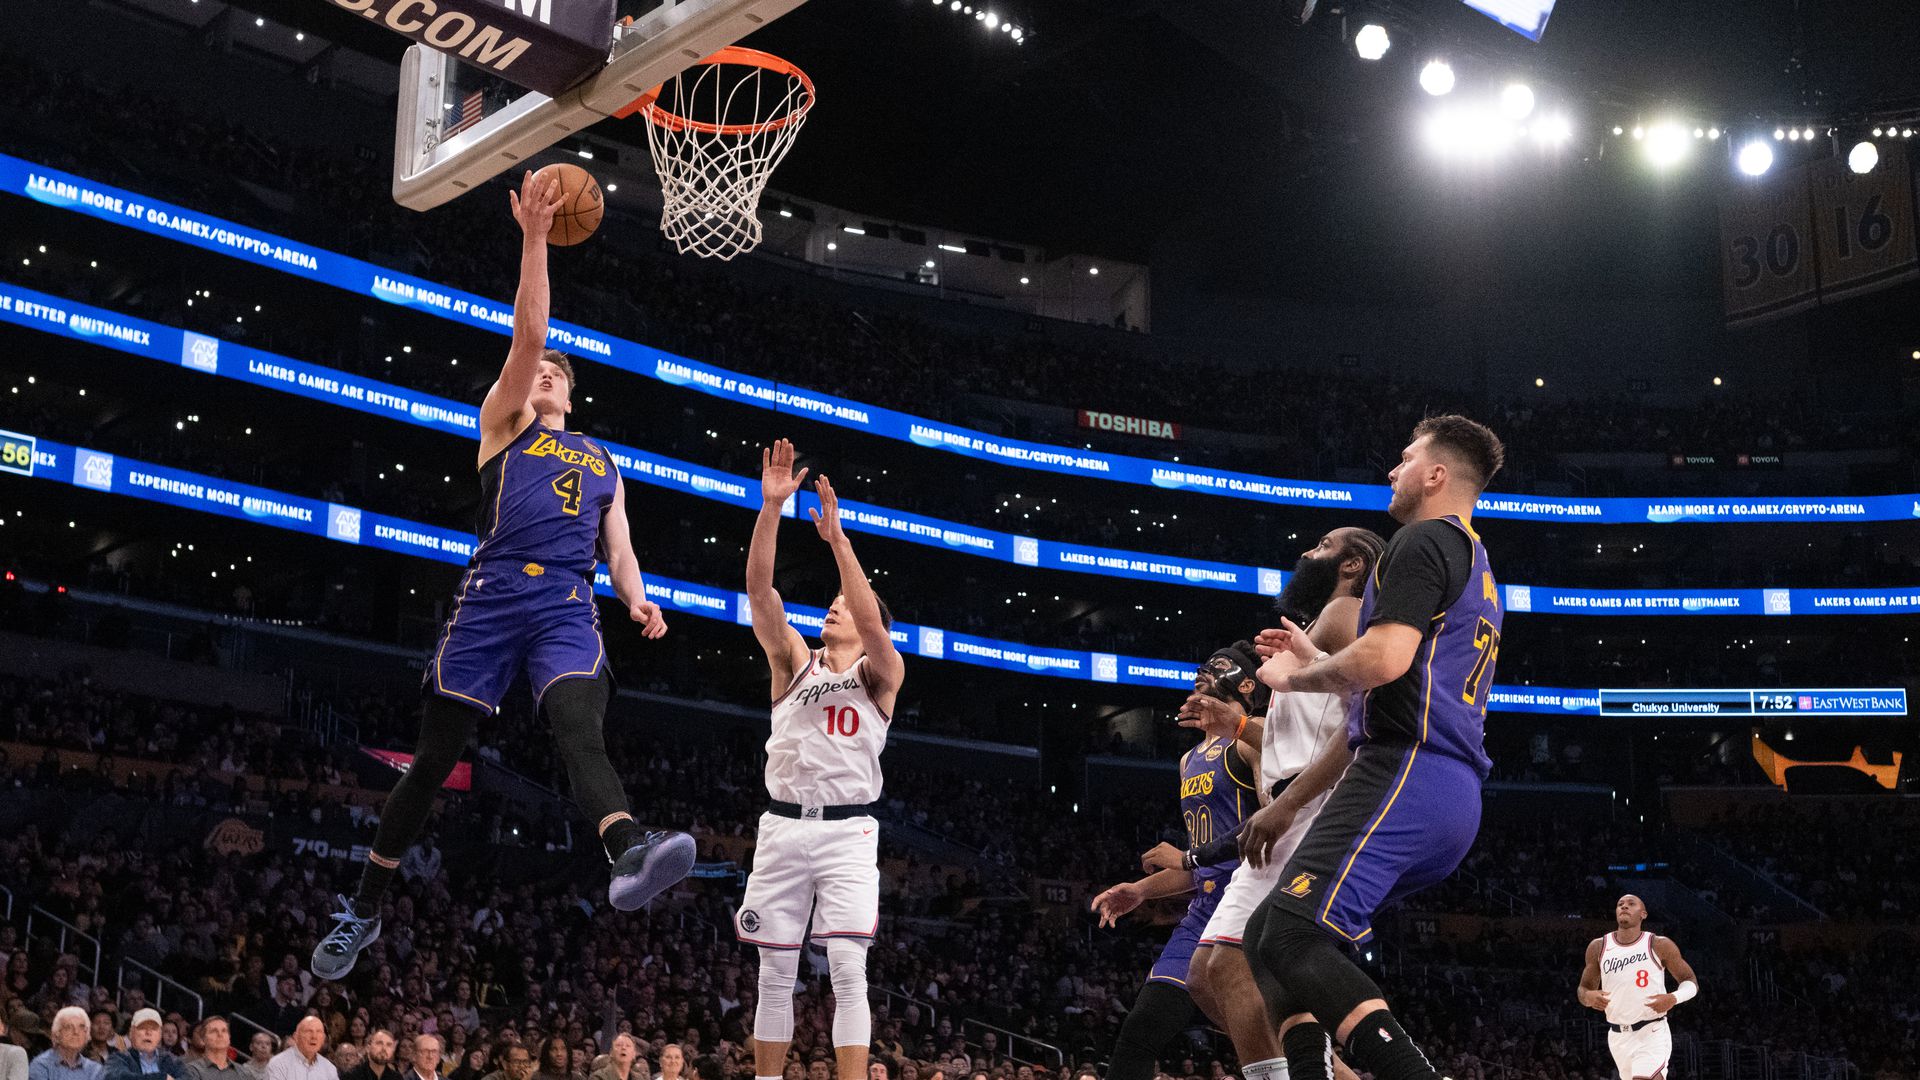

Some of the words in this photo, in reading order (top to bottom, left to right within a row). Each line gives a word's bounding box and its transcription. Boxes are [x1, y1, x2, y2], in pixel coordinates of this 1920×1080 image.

[29, 174, 77, 200] LEARN
[82, 190, 123, 213] MORE
[126, 204, 144, 218] AT
[147, 209, 317, 269] GO.AMEX/CRYPTO-ARENA
[1835, 195, 1894, 259] 16
[1728, 221, 1800, 290] 30
[373, 276, 414, 298] LEARN
[417, 289, 450, 309] MORE
[453, 300, 468, 313] AT
[15, 300, 66, 323] BETTER
[70, 315, 150, 345] #WITHAMEX
[657, 360, 690, 379] LEARN
[693, 370, 721, 388] MORE
[723, 379, 736, 391] AT
[249, 360, 296, 382] LAKERS
[299, 373, 339, 393] GAMES
[342, 385, 364, 399] ARE
[367, 391, 408, 411] BETTER
[411, 403, 477, 428] #WITHAMEX
[1086, 411, 1175, 440] TOSHIBA
[523, 432, 606, 476] LAKERS
[911, 424, 942, 440] LEARN
[943, 433, 971, 447] MORE
[972, 439, 984, 451] AT
[985, 443, 1109, 471] GO.AMEX/CRYPTO-ARENA
[1686, 456, 1715, 464] TOYOTA
[1751, 456, 1780, 464] TOYOTA
[552, 468, 583, 516] 4
[633, 459, 652, 474] ARE
[654, 465, 689, 482] BETTER
[691, 475, 746, 496] #WITHAMEX
[1152, 468, 1184, 482] LEARN
[1186, 474, 1214, 486] MORE
[1215, 477, 1228, 488] AT
[1229, 480, 1352, 500] GO.AMEX/CRYPTO-ARENA
[130, 472, 204, 498] EXPERIENCE
[207, 489, 241, 505] MORE
[243, 497, 312, 521] #WITHAMEX
[1476, 500, 1602, 515] GO.AMEX/CRYPTO-ARENA
[1648, 504, 1682, 515] LEARN
[1685, 504, 1715, 516] MORE
[1717, 504, 1730, 515] AT
[1732, 504, 1865, 515] GO.AMEX/CRYPTO-ARENA
[375, 525, 439, 548] EXPERIENCE
[441, 540, 471, 555] MORE
[858, 513, 889, 527] GAMES
[890, 519, 908, 532] ARE
[910, 523, 942, 538] BETTER
[943, 531, 994, 548] #WITHAMEX
[1061, 552, 1095, 565] LAKERS
[1097, 557, 1128, 569] GAMES
[1130, 560, 1148, 572] ARE
[1150, 563, 1183, 575] BETTER
[1184, 568, 1237, 582] #WITHAMEX
[646, 584, 671, 598] MORE
[673, 590, 726, 609] #WITHAMEX
[1553, 596, 1587, 607] LAKERS
[1590, 597, 1622, 608] GAMES
[1624, 597, 1642, 608] ARE
[1645, 597, 1680, 608] BETTER
[1683, 597, 1740, 609] #WITHAMEX
[1815, 597, 1851, 607] LAKERS
[1853, 596, 1887, 607] GAMES
[1889, 596, 1908, 606] ARE
[954, 642, 1002, 658] EXPERIENCE
[1003, 650, 1027, 663] MORE
[1028, 655, 1080, 668] #WITHAMEX
[1128, 666, 1180, 679] EXPERIENCE
[1488, 693, 1535, 704] XPERIENCE
[1537, 695, 1561, 706] MORE
[1632, 702, 1669, 717] Chukyo
[1672, 702, 1720, 717] University
[1760, 696, 1793, 710] 7:52
[823, 705, 860, 737] 10
[1603, 952, 1648, 975] Clippers
[1635, 969, 1649, 988] 8
